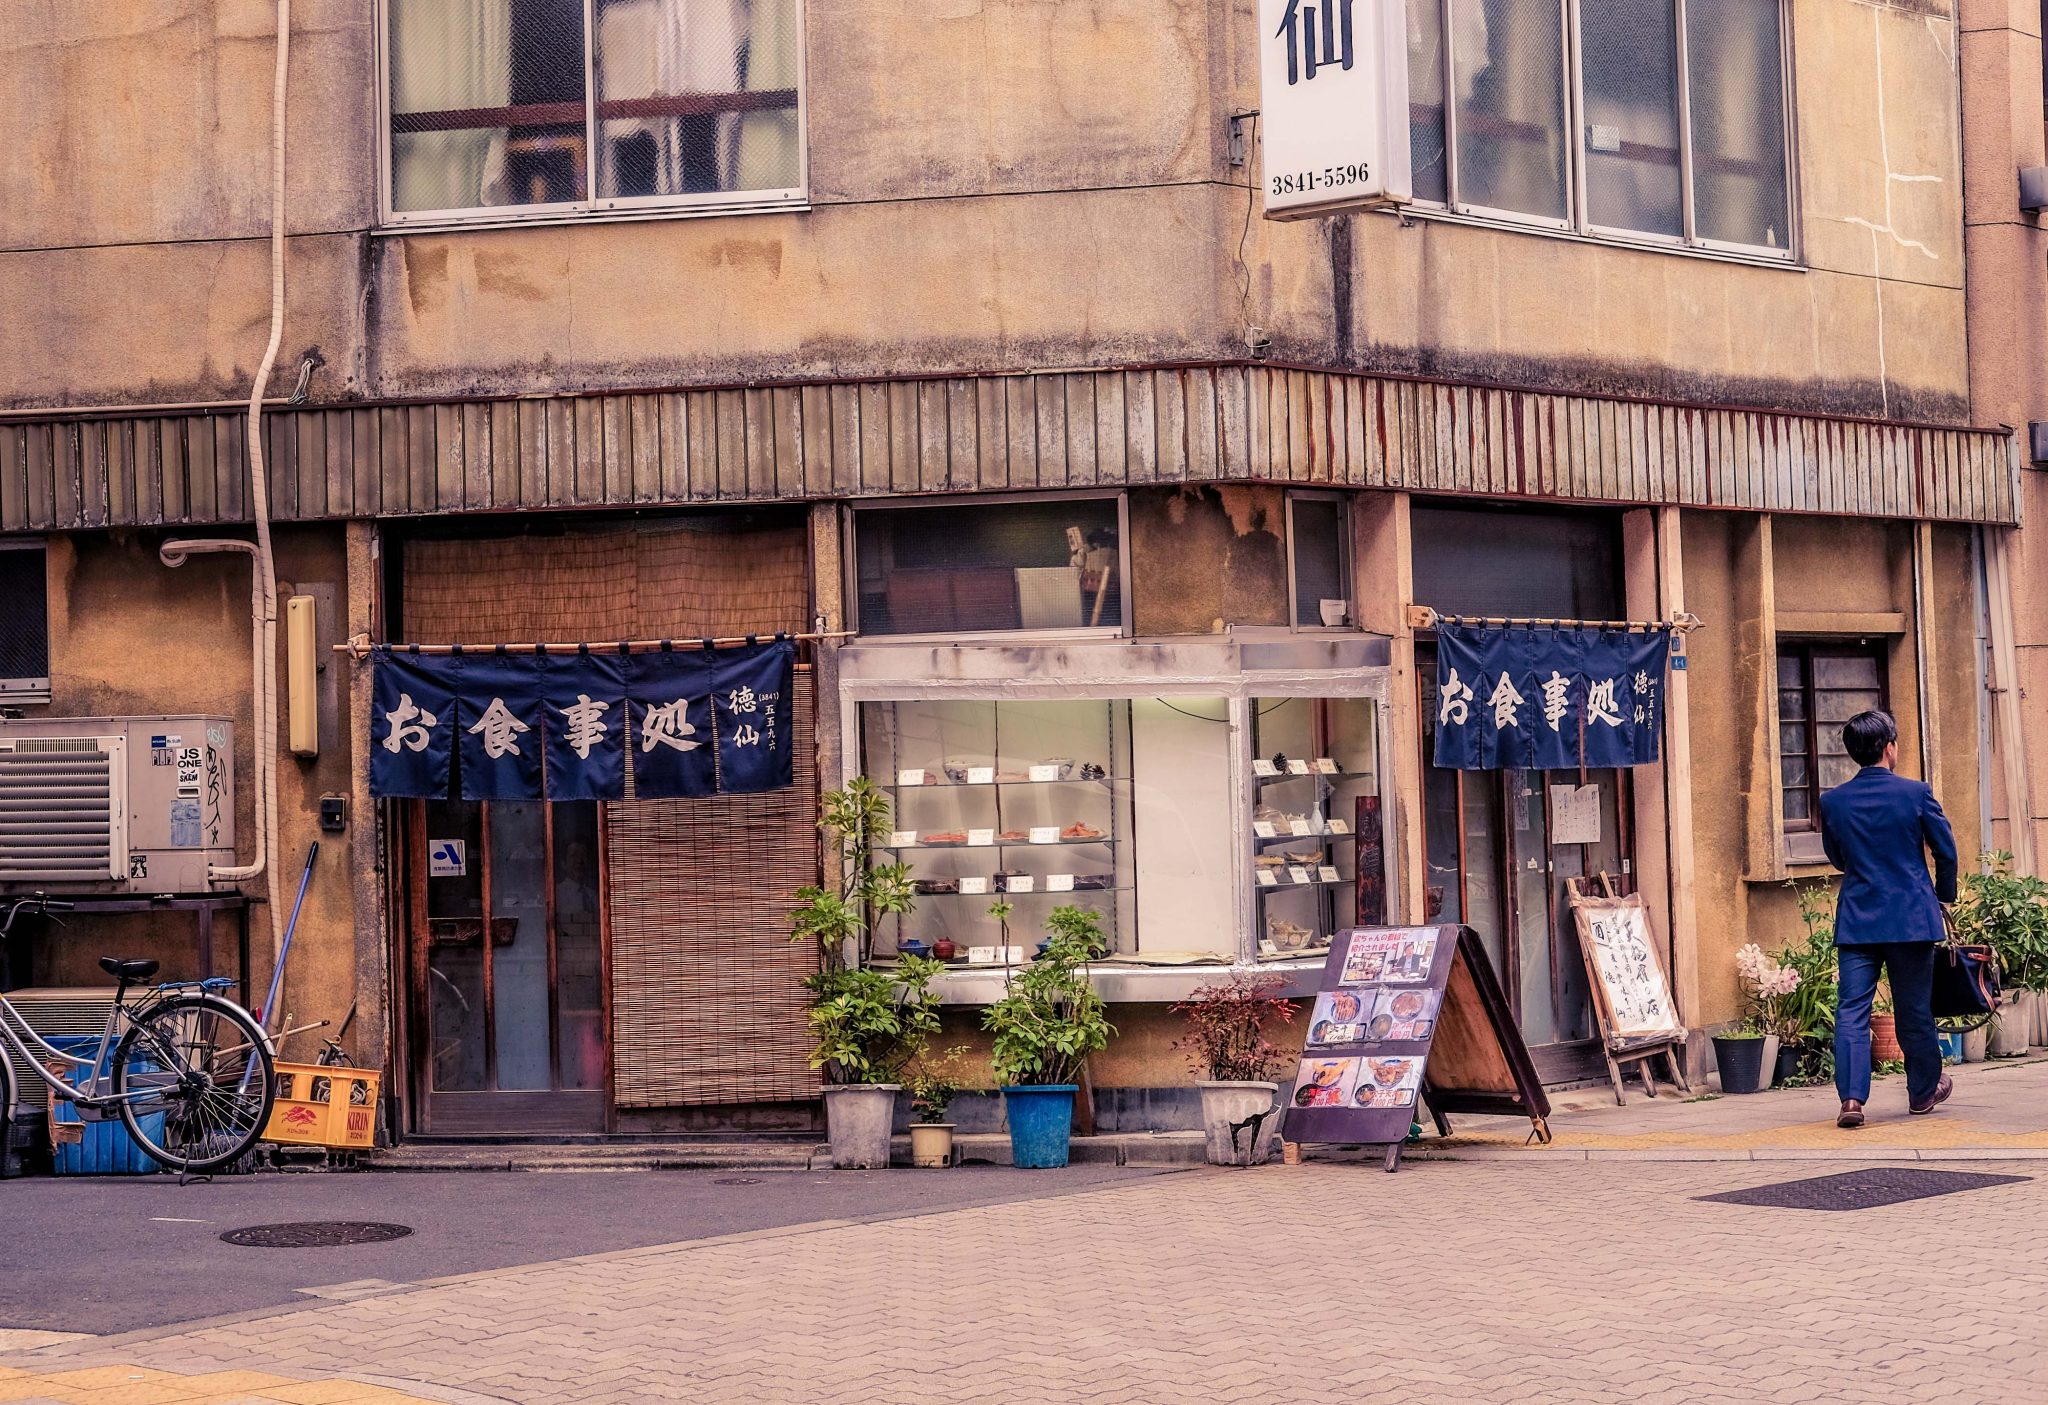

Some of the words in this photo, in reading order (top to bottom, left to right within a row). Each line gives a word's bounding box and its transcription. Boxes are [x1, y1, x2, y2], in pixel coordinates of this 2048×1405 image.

[1275, 0, 1353, 85] 仙
[1272, 163, 1369, 195] 3841-5596
[729, 685, 760, 748] 徳仙
[1440, 667, 1625, 732] お食事処
[382, 693, 702, 760] お食事処
[765, 704, 776, 751] 五五九六
[177, 759, 203, 768] ONE
[179, 748, 200, 759] JS
[346, 1111, 370, 1131] KIRIN
